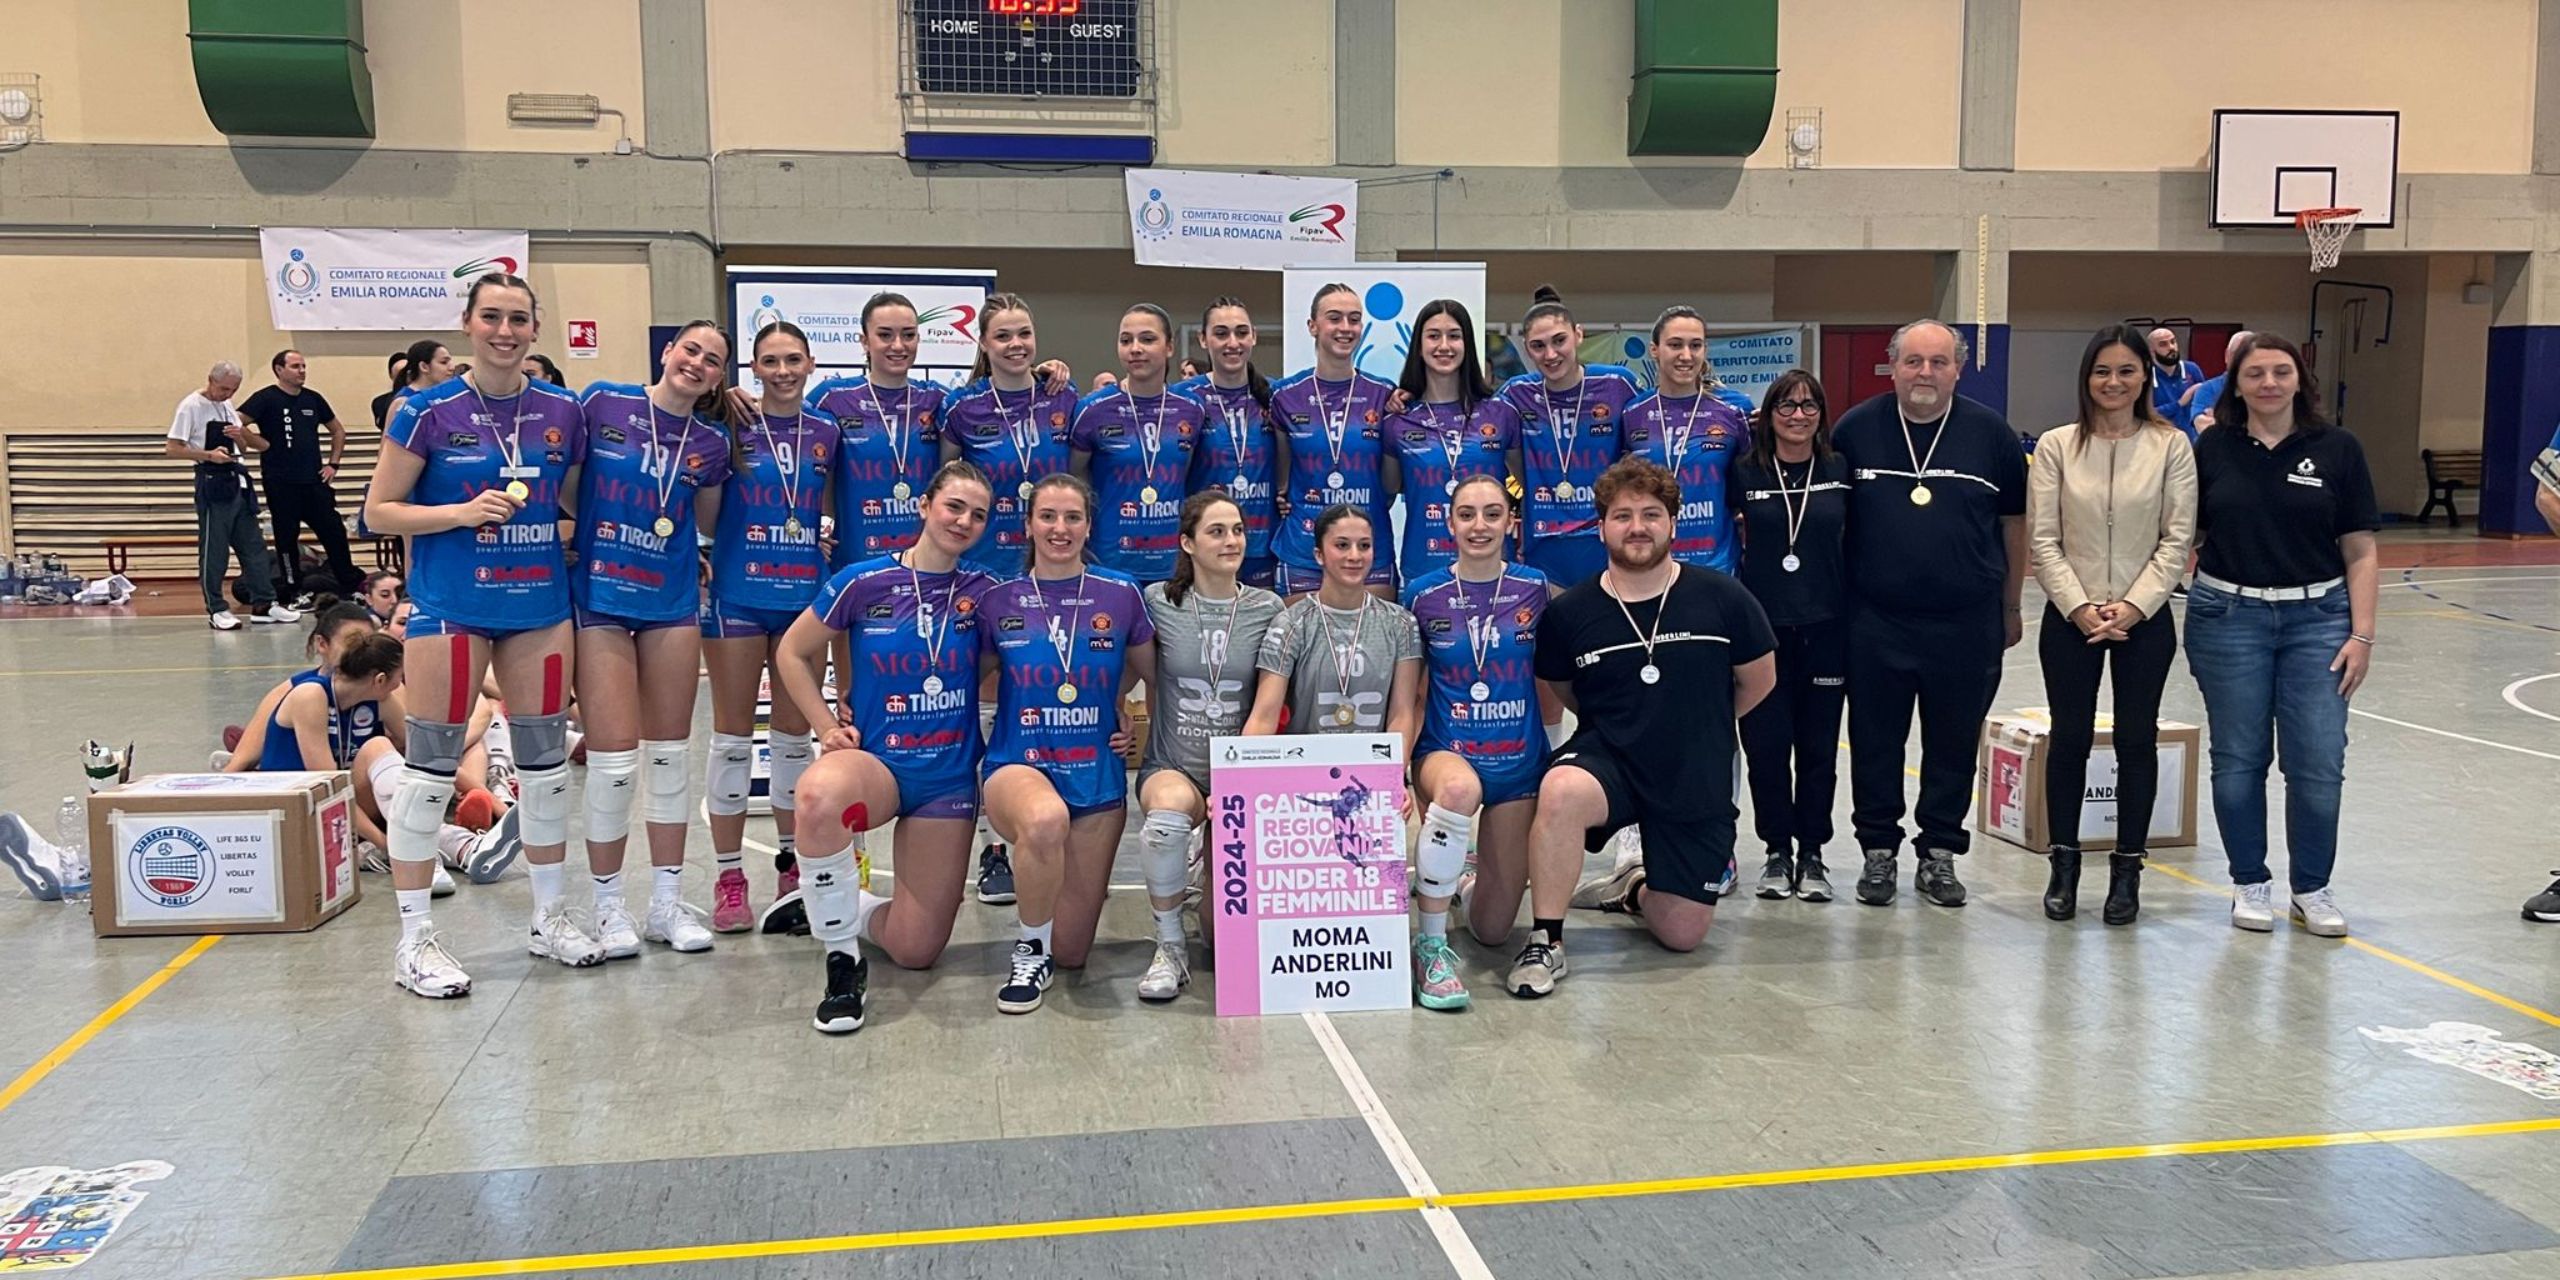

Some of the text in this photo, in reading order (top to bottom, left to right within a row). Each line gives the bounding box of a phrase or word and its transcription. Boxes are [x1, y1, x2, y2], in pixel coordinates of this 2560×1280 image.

[931, 20, 979, 34] HOME
[1069, 24, 1123, 38] GUEST
[1182, 210, 1283, 223] COMITATO REGIONALE
[1182, 225, 1282, 240] EMILIA ROMAGNA
[1300, 226, 1324, 235] Fipav
[329, 270, 447, 280] COMITATO REGIONALE
[331, 286, 376, 298] EMILIA
[380, 287, 447, 298] ROMAGNA
[797, 315, 850, 326] COMITATO
[805, 332, 847, 343] MILIA
[927, 329, 954, 337] Fipav
[1729, 336, 1793, 349] COMITATO
[1226, 408, 1247, 438] 11
[1330, 410, 1344, 442] 5
[1552, 408, 1577, 440] 15
[1143, 422, 1160, 452] 8
[1446, 430, 1463, 456] 3
[777, 442, 794, 475] 9
[1322, 488, 1370, 504] TIRONI
[917, 602, 933, 638] 6
[1198, 629, 1227, 665] 18
[908, 688, 966, 713] TIRONI
[1470, 699, 1525, 720] TIRONI
[1041, 706, 1099, 726] TIRONI
[1254, 791, 1393, 813] CAMPNE
[1263, 815, 1394, 836] REGIONALE
[216, 835, 233, 843] LIFE
[234, 835, 249, 843] 365
[1264, 836, 1394, 858] GIOVANILE
[1223, 794, 1248, 916] 2024-25
[225, 869, 255, 877] VOLLEY
[1256, 866, 1380, 891] UNDER 18
[1257, 889, 1398, 914] FEMMINILE
[1293, 927, 1370, 948] MOMA
[1271, 951, 1393, 974] ANDERLINI
[1315, 980, 1351, 999] MO
